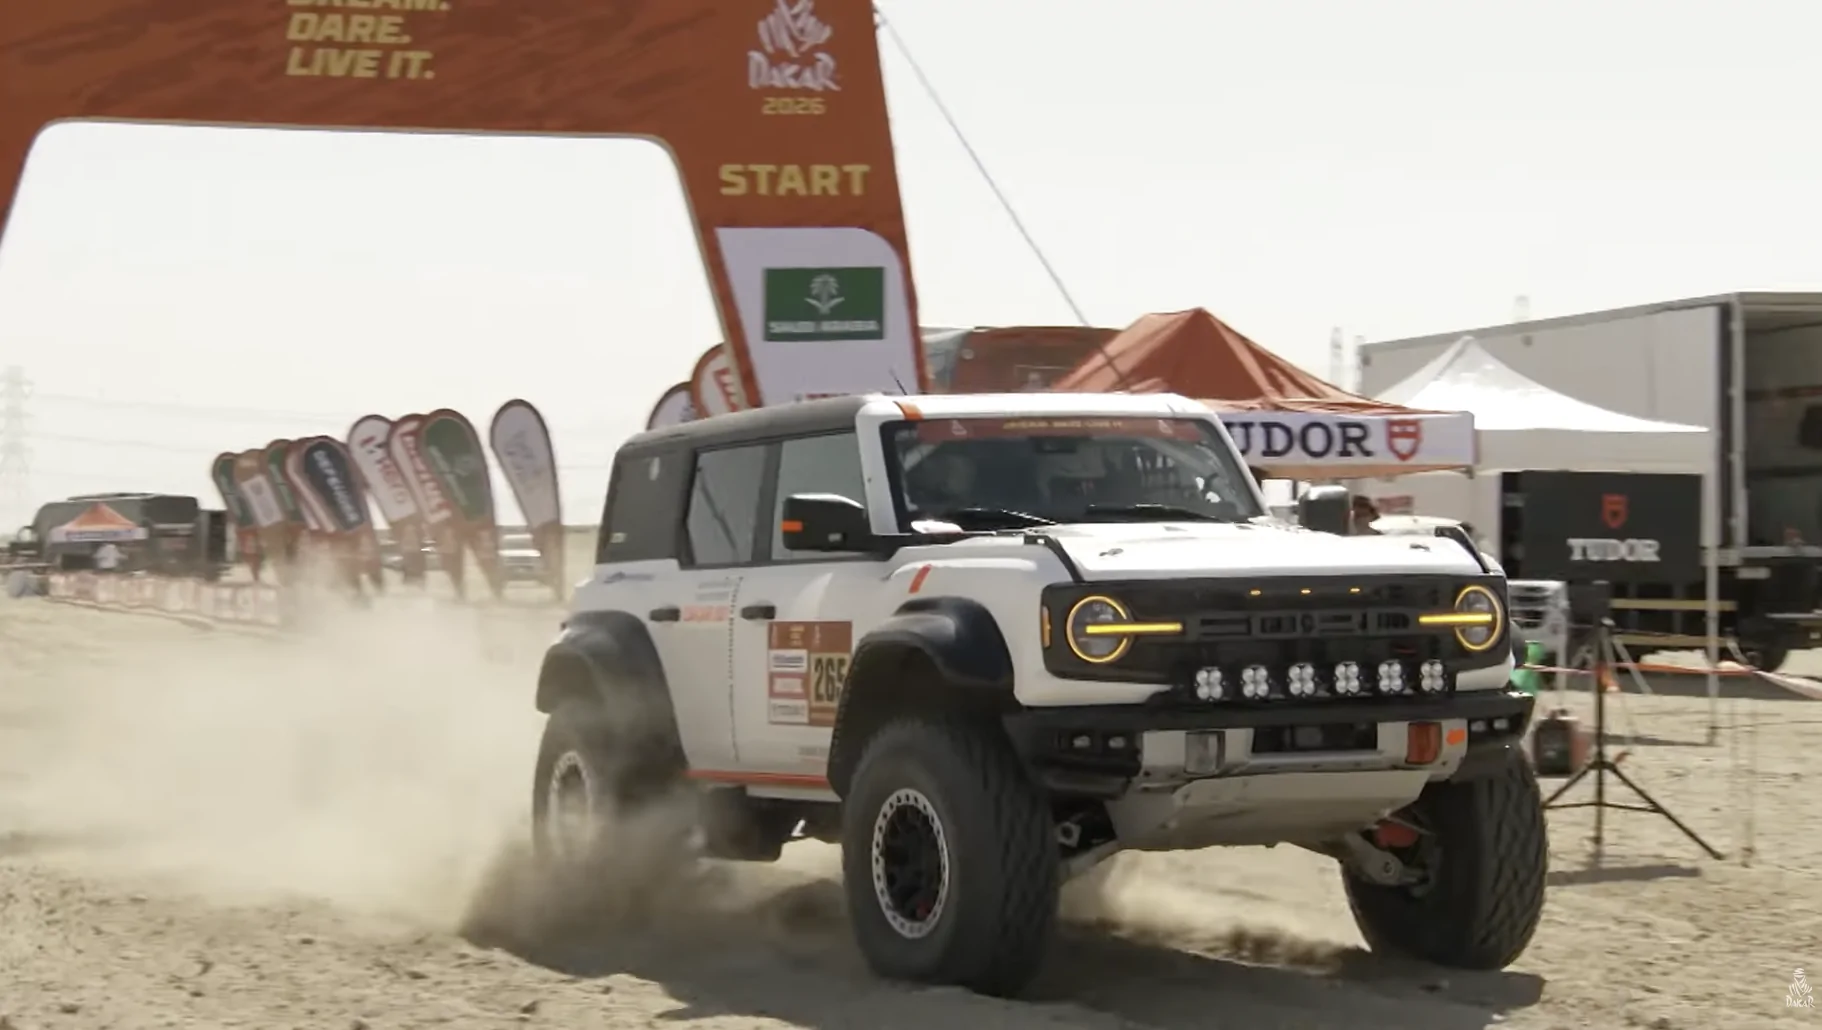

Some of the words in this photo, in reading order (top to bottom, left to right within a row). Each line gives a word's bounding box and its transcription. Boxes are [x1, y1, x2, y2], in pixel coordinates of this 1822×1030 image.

[286, 12, 412, 44] DARE.
[285, 46, 383, 78] LIVE
[386, 50, 436, 80] IT.
[762, 97, 827, 115] 2026
[719, 164, 871, 196] START
[1223, 421, 1374, 458] UDOR
[1566, 538, 1661, 561] TUDOR
[814, 657, 847, 702] 265
